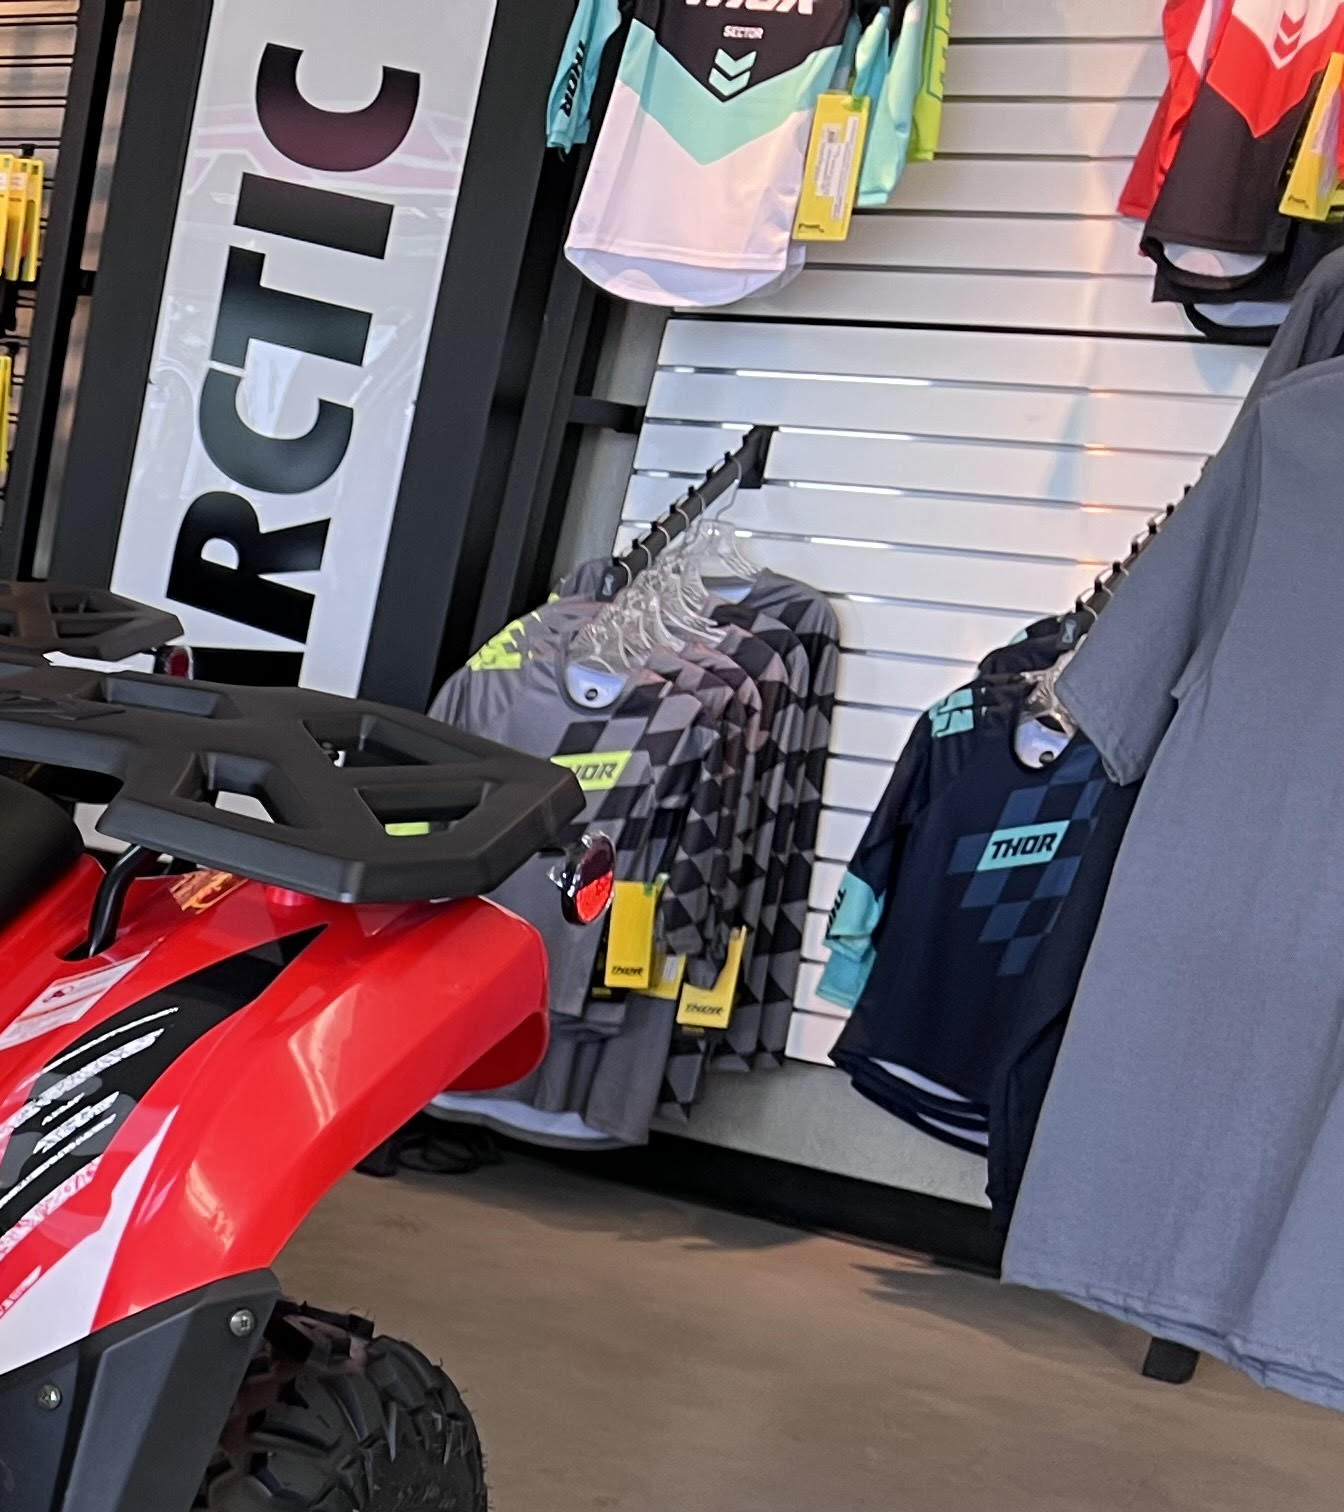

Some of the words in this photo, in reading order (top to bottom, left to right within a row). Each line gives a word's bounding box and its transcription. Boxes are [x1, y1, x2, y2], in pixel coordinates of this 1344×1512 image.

[723, 25, 764, 40] SECTOR
[560, 40, 587, 118] THOR
[167, 42, 421, 687] RCTIC
[574, 762, 618, 781] HOR
[991, 833, 1057, 860] THOR
[611, 965, 645, 978] THOR
[685, 1002, 725, 1017] THOR
